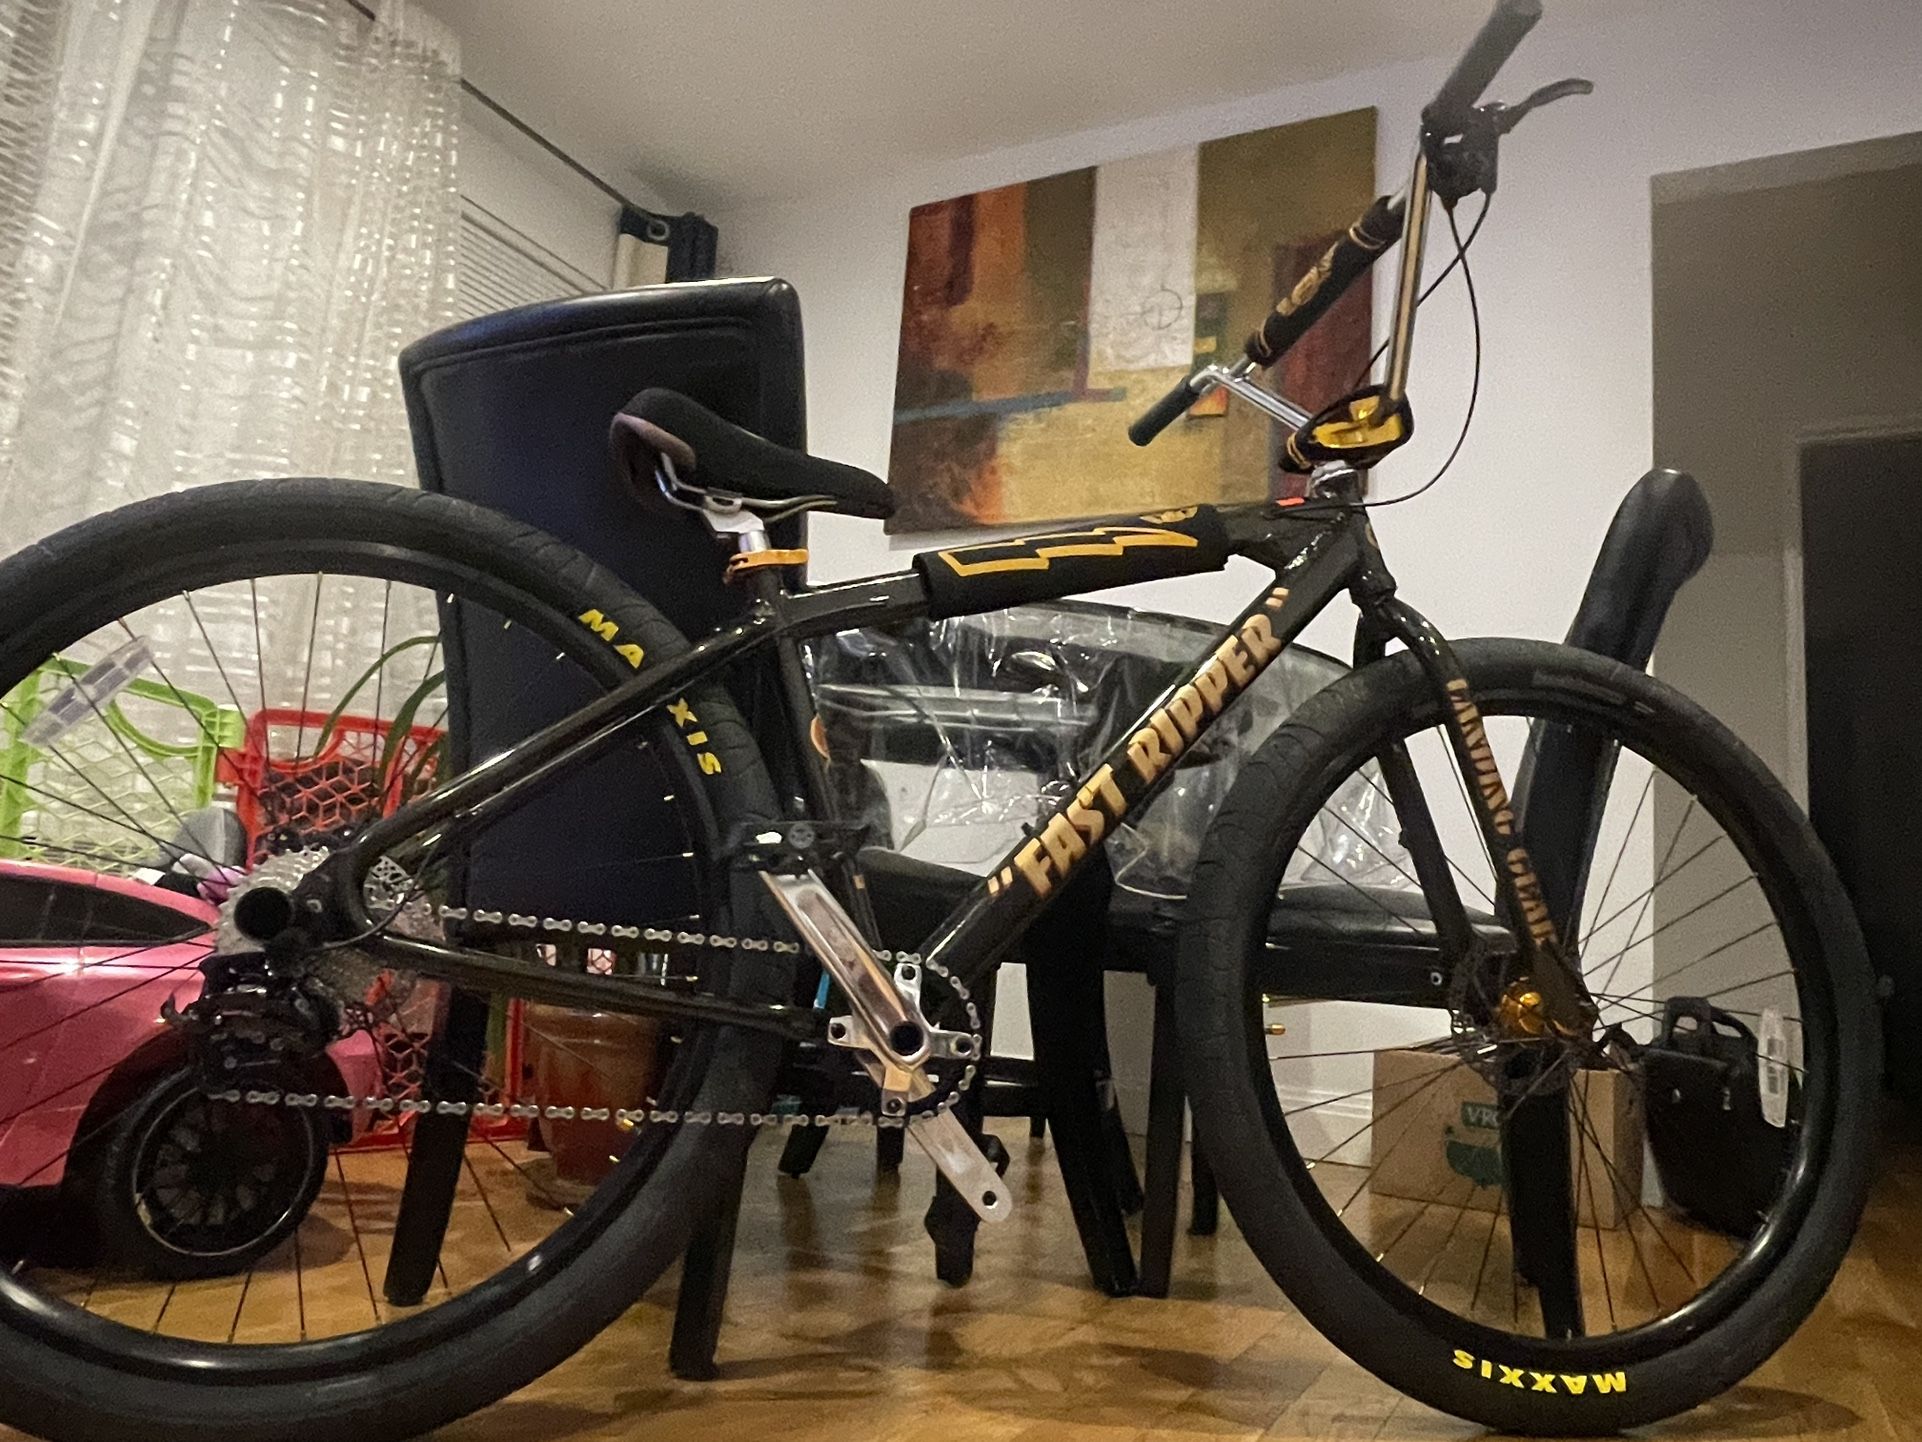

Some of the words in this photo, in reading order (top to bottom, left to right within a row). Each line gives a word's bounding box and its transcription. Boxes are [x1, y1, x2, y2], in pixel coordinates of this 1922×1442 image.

[578, 608, 722, 775] MAXIS
[1446, 677, 1514, 836] LANDING
[1506, 848, 1556, 949] GEAR
[1453, 1349, 1627, 1395] MAXXIS
